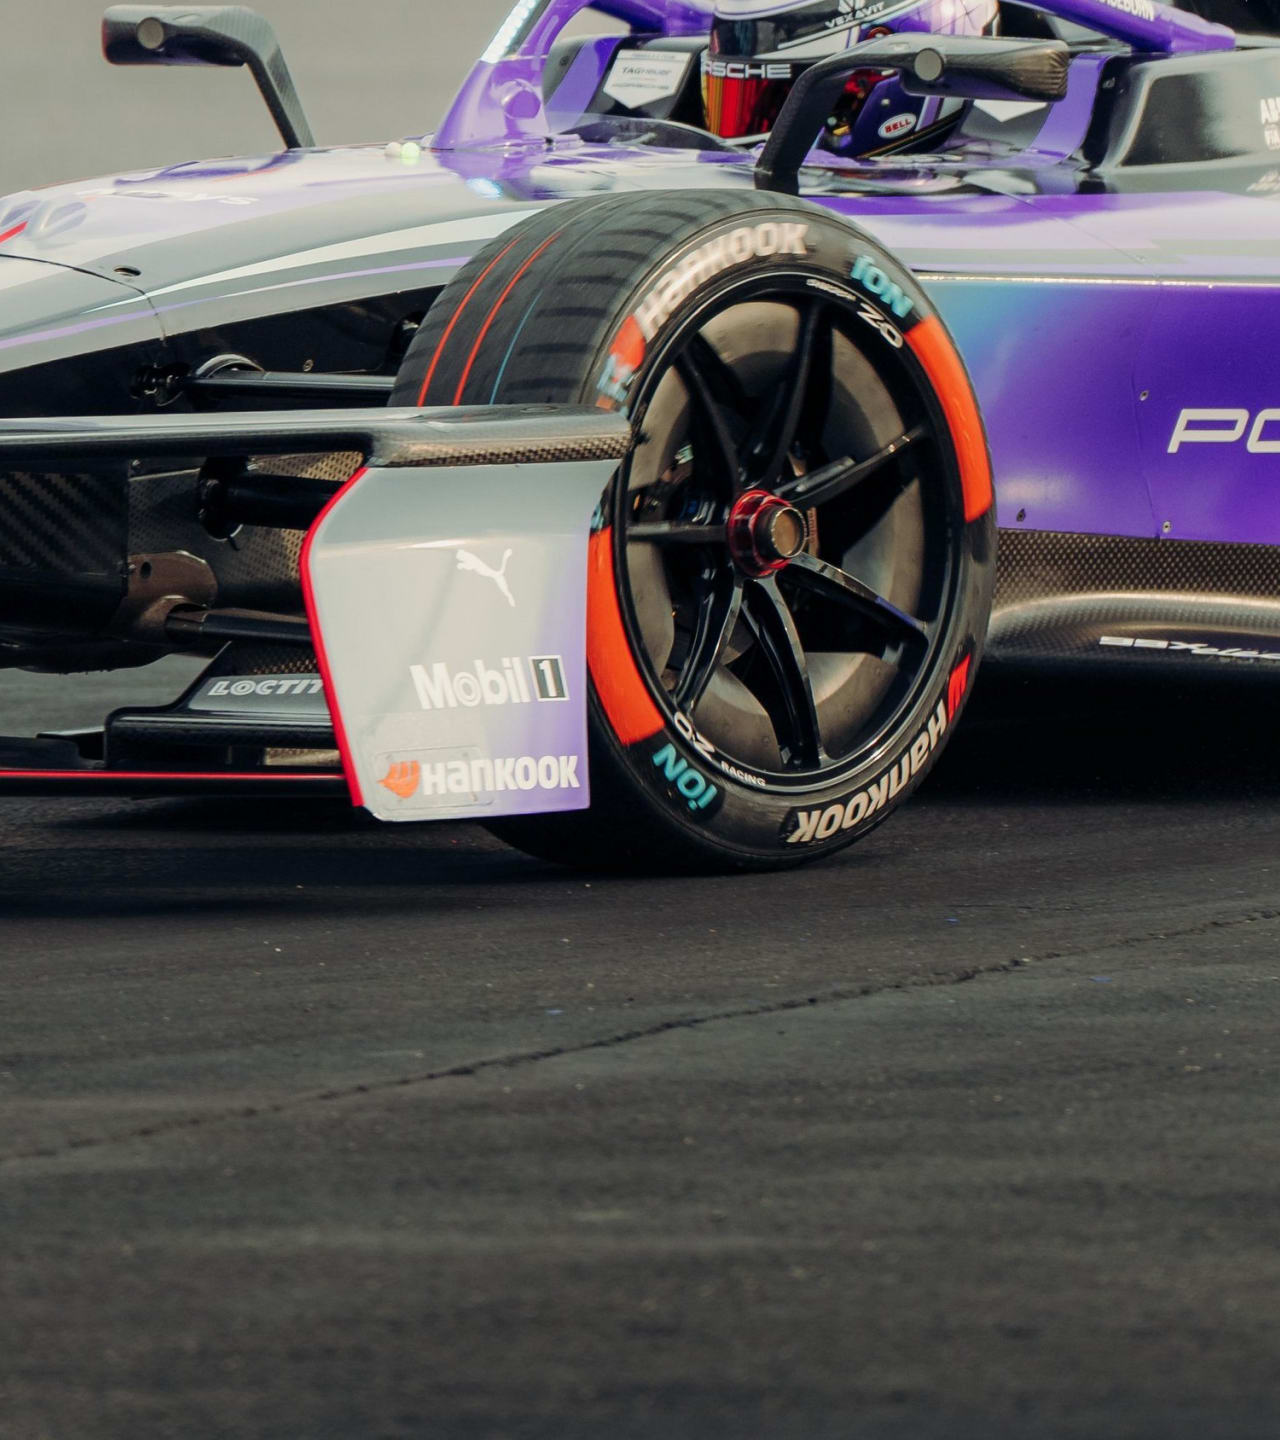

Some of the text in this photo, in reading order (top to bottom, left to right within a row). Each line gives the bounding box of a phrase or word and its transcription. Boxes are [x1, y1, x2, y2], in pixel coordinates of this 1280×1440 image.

[885, 118, 912, 134] BELL
[208, 679, 323, 696] LOCTIT
[410, 658, 531, 710] Mobil
[721, 760, 766, 787] RACING
